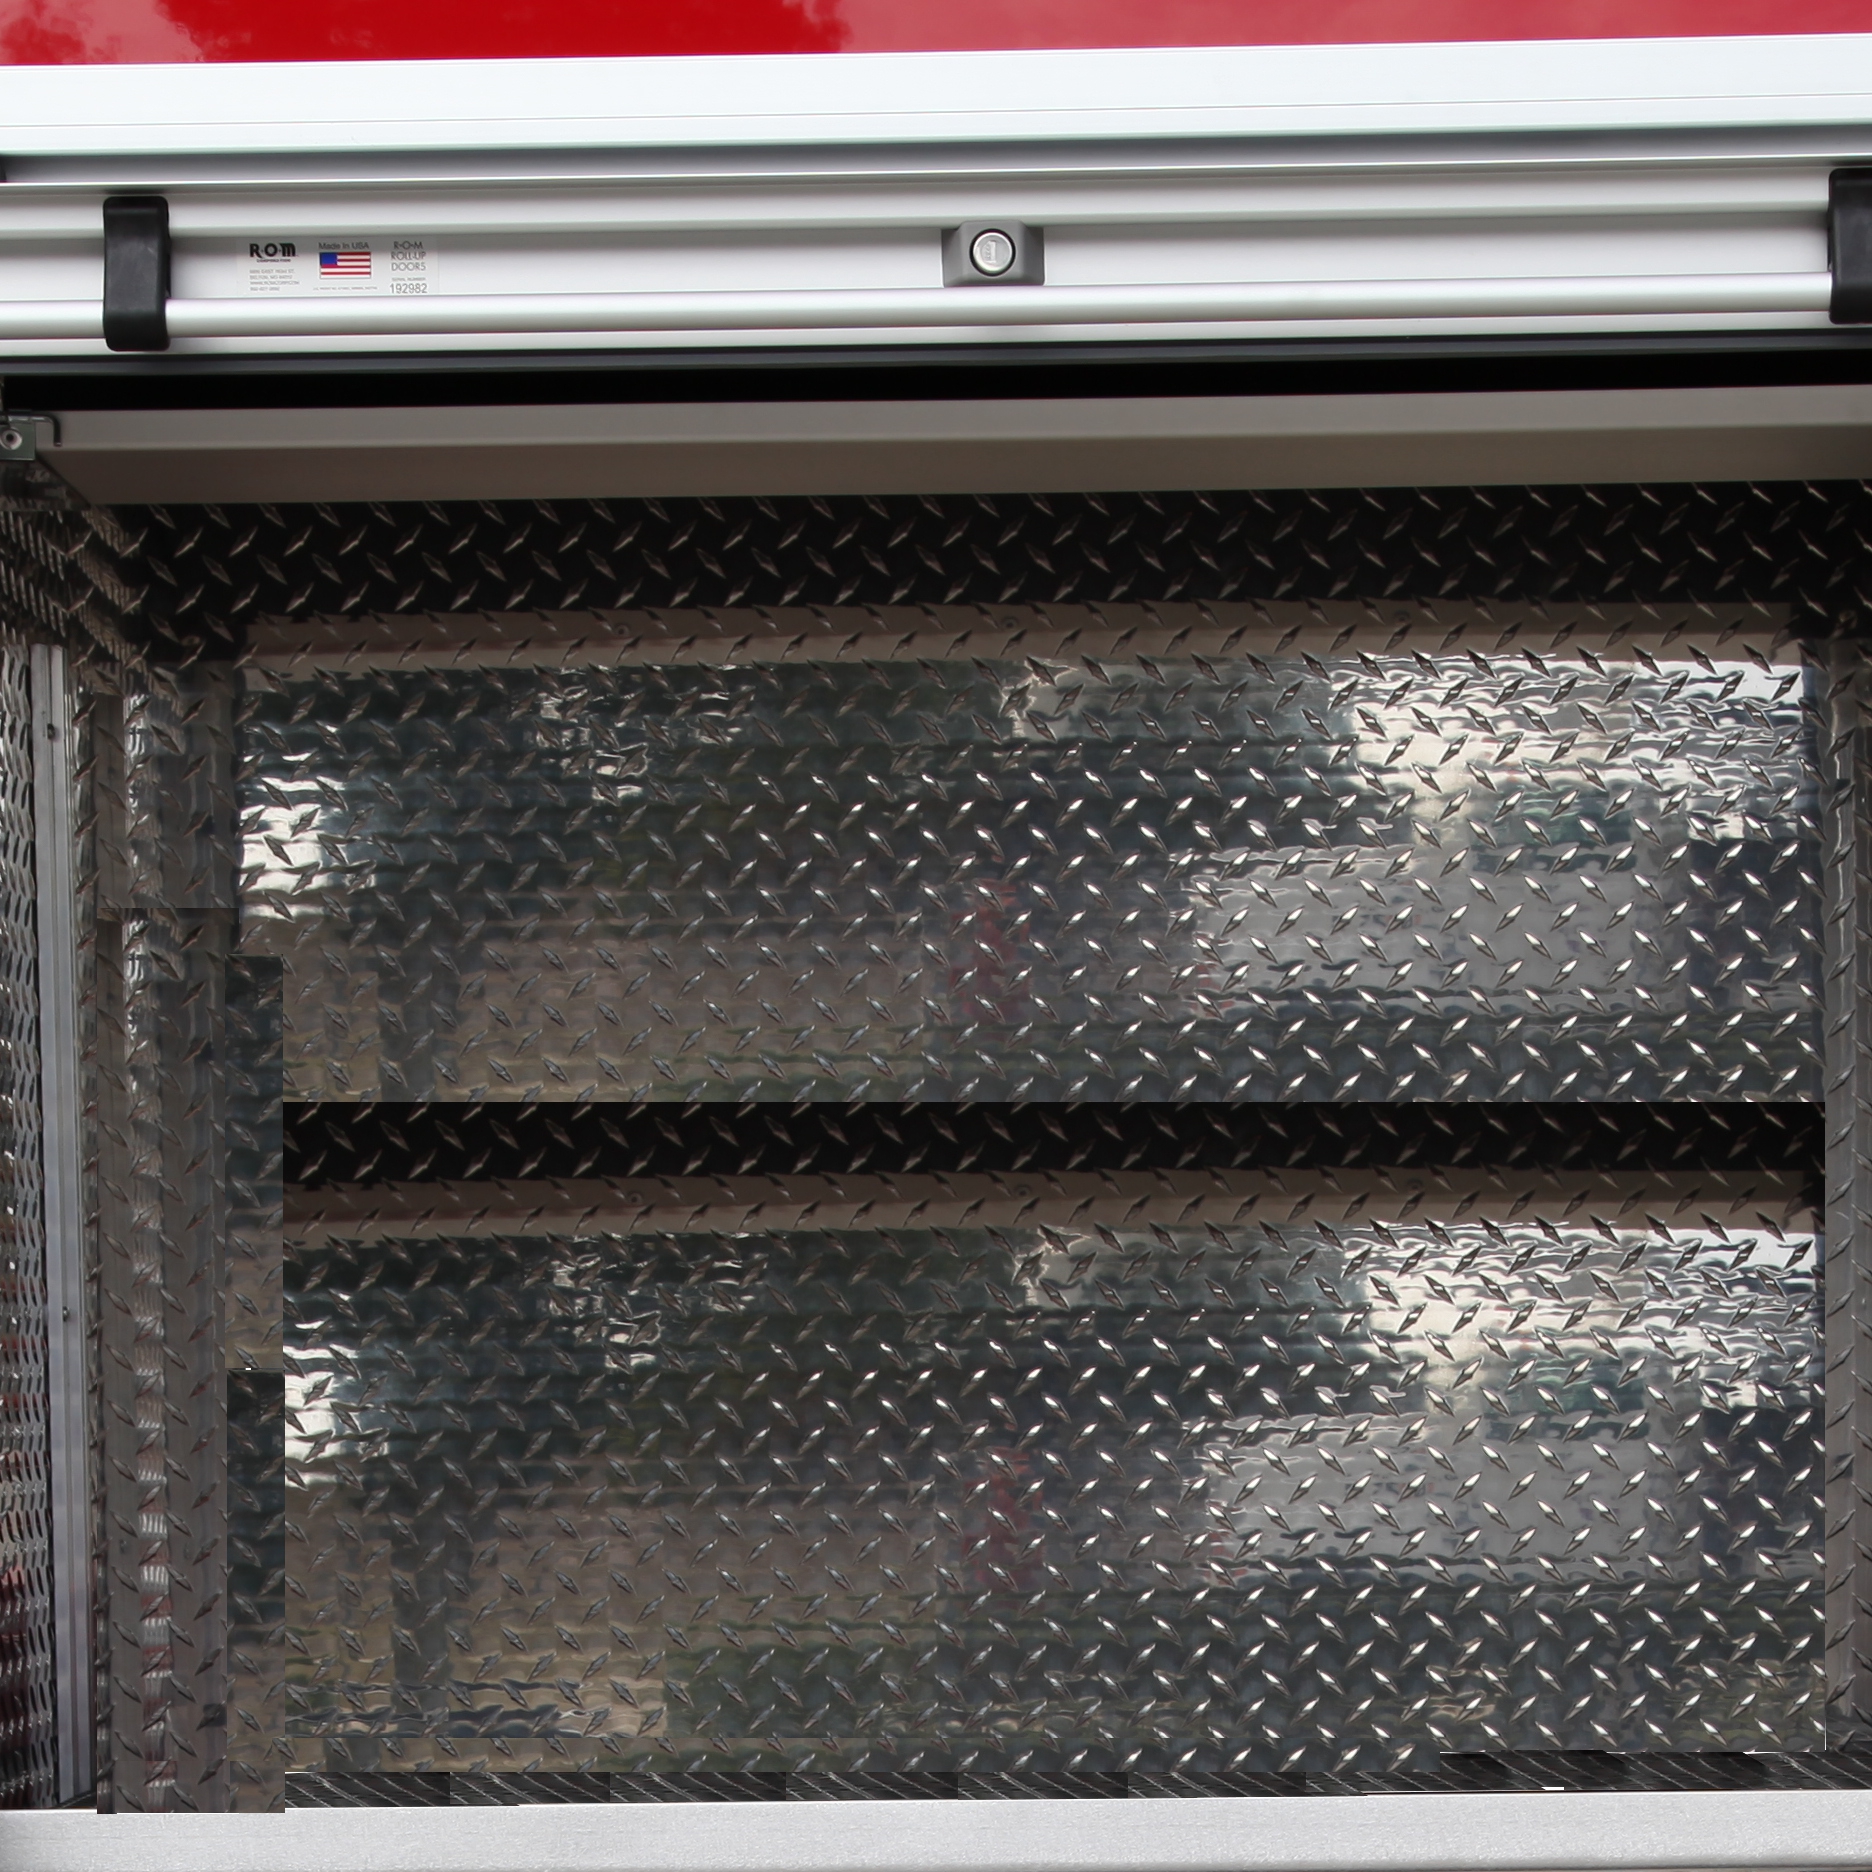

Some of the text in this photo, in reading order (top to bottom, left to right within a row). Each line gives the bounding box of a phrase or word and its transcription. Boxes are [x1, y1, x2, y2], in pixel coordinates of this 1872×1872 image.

[318, 242, 341, 250] Made
[351, 242, 370, 250] USA
[391, 262, 427, 271] DOORS
[389, 283, 428, 294] 192982
